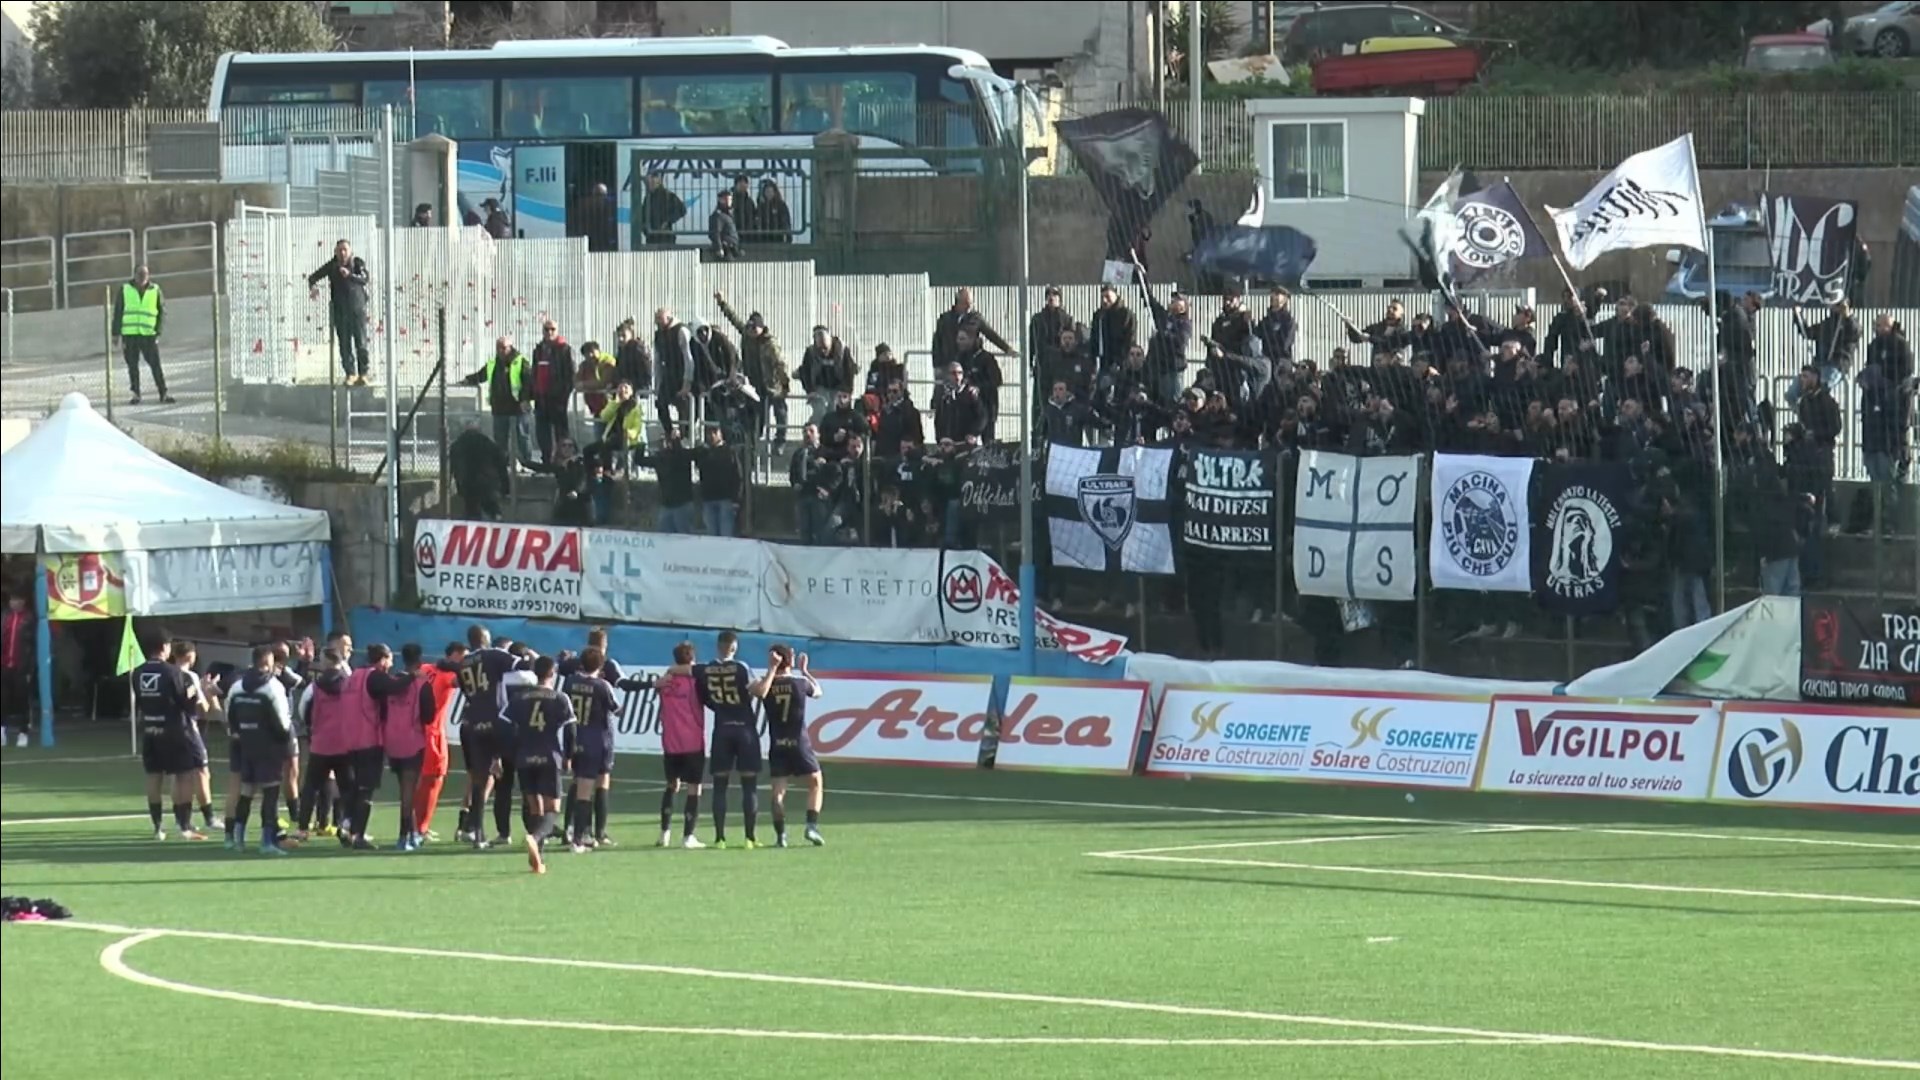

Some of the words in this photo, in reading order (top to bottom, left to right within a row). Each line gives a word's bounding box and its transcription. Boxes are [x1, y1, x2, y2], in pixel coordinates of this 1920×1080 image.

[525, 166, 556, 184] F.lli
[1449, 474, 1506, 505] MACINA
[1213, 497, 1269, 516] DIFESI
[1184, 520, 1208, 540] MAI
[1211, 525, 1270, 543] ARRESI
[195, 541, 313, 573] MANCA
[440, 524, 580, 572] MURA
[1462, 556, 1495, 576] CHE
[439, 571, 580, 596] PREFABBRICATI
[807, 577, 932, 597] PETRETTO
[1546, 574, 1605, 599] ULTRAS
[456, 596, 508, 610] TORRES
[951, 630, 1000, 644] PORTO
[1001, 632, 1060, 648] TORES
[1859, 640, 1889, 671] ZIA
[708, 675, 740, 705] 55
[1802, 679, 1837, 698] CUCINA
[529, 701, 547, 732] 4
[775, 694, 791, 722] 7
[808, 688, 1112, 754] Ardea
[1223, 722, 1311, 743] SORGENTE
[1385, 728, 1478, 750] SORGENTE
[1515, 709, 1685, 762] VIGILPOL
[1154, 743, 1210, 762] Solare
[1215, 745, 1305, 767] Costruzioni
[1310, 748, 1370, 769] Solare
[1376, 752, 1472, 776] Costruzioni
[1825, 725, 1920, 796] Cha
[1508, 769, 1524, 785] La
[1527, 770, 1586, 787] sicurezza
[1588, 772, 1602, 788] al
[1604, 774, 1628, 789] tuo
[1630, 775, 1682, 792] servizio
